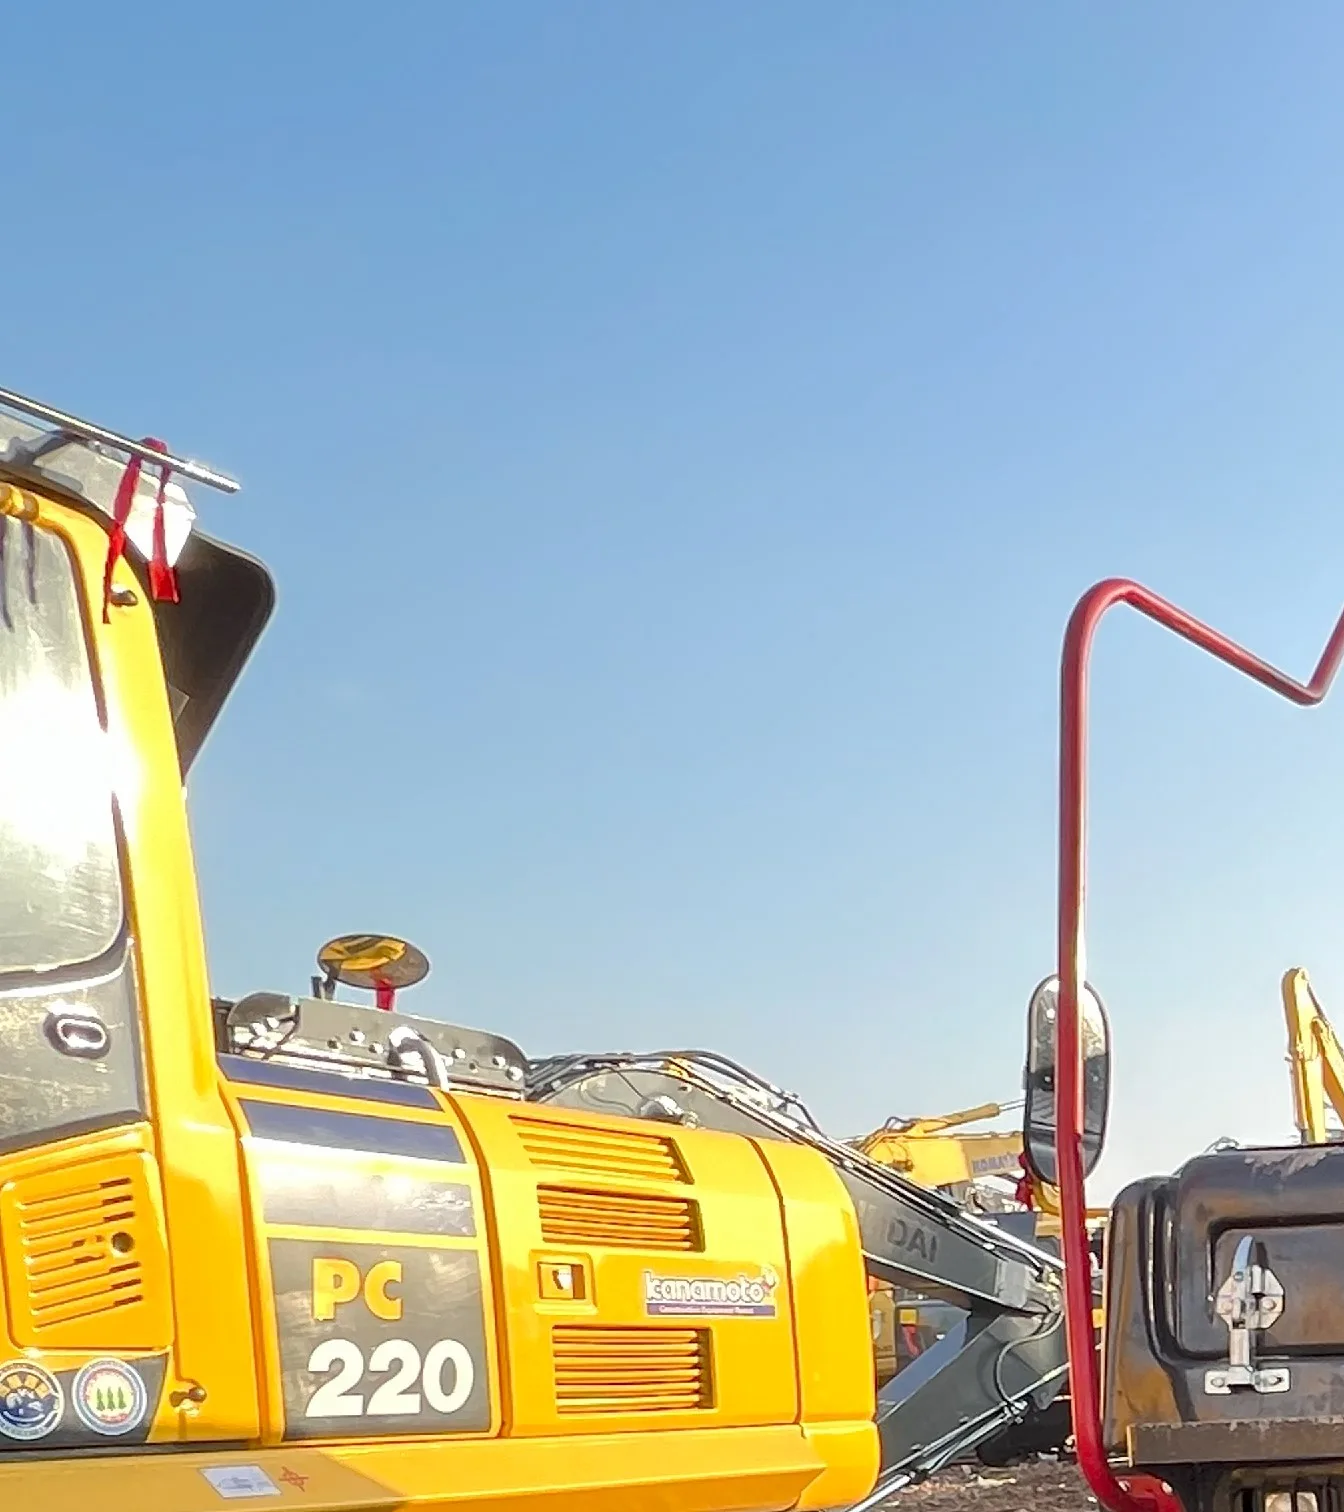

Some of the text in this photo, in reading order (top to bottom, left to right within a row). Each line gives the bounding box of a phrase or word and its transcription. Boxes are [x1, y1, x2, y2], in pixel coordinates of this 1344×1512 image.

[311, 1258, 403, 1321] PC
[645, 1270, 764, 1303] kanamoto
[305, 1338, 475, 1418] 220
